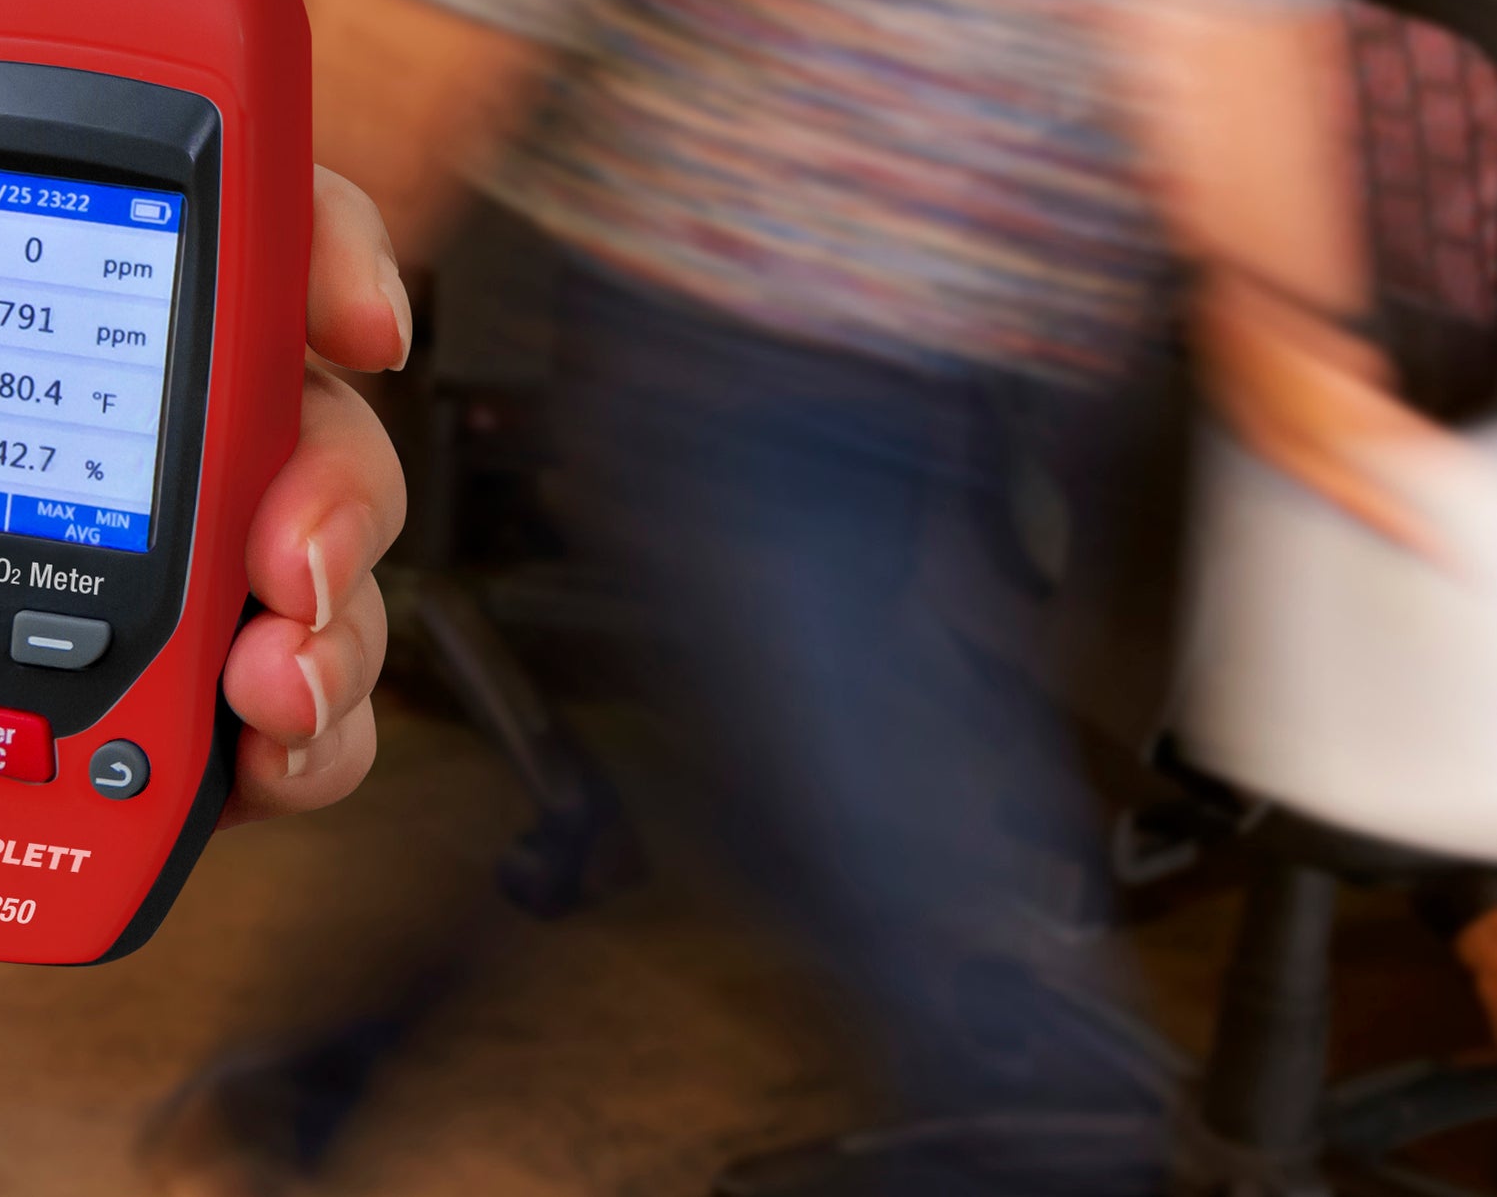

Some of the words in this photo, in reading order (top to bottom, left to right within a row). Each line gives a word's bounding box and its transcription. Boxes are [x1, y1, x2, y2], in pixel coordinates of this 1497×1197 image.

[37, 189, 91, 213] 23:22
[24, 237, 43, 264] 0
[103, 258, 154, 281] ppm
[96, 325, 147, 348] ppm
[85, 460, 105, 482] %
[37, 501, 75, 522] MAX
[96, 508, 131, 529] MIN
[65, 525, 101, 545] AVG
[29, 562, 105, 596] Meter
